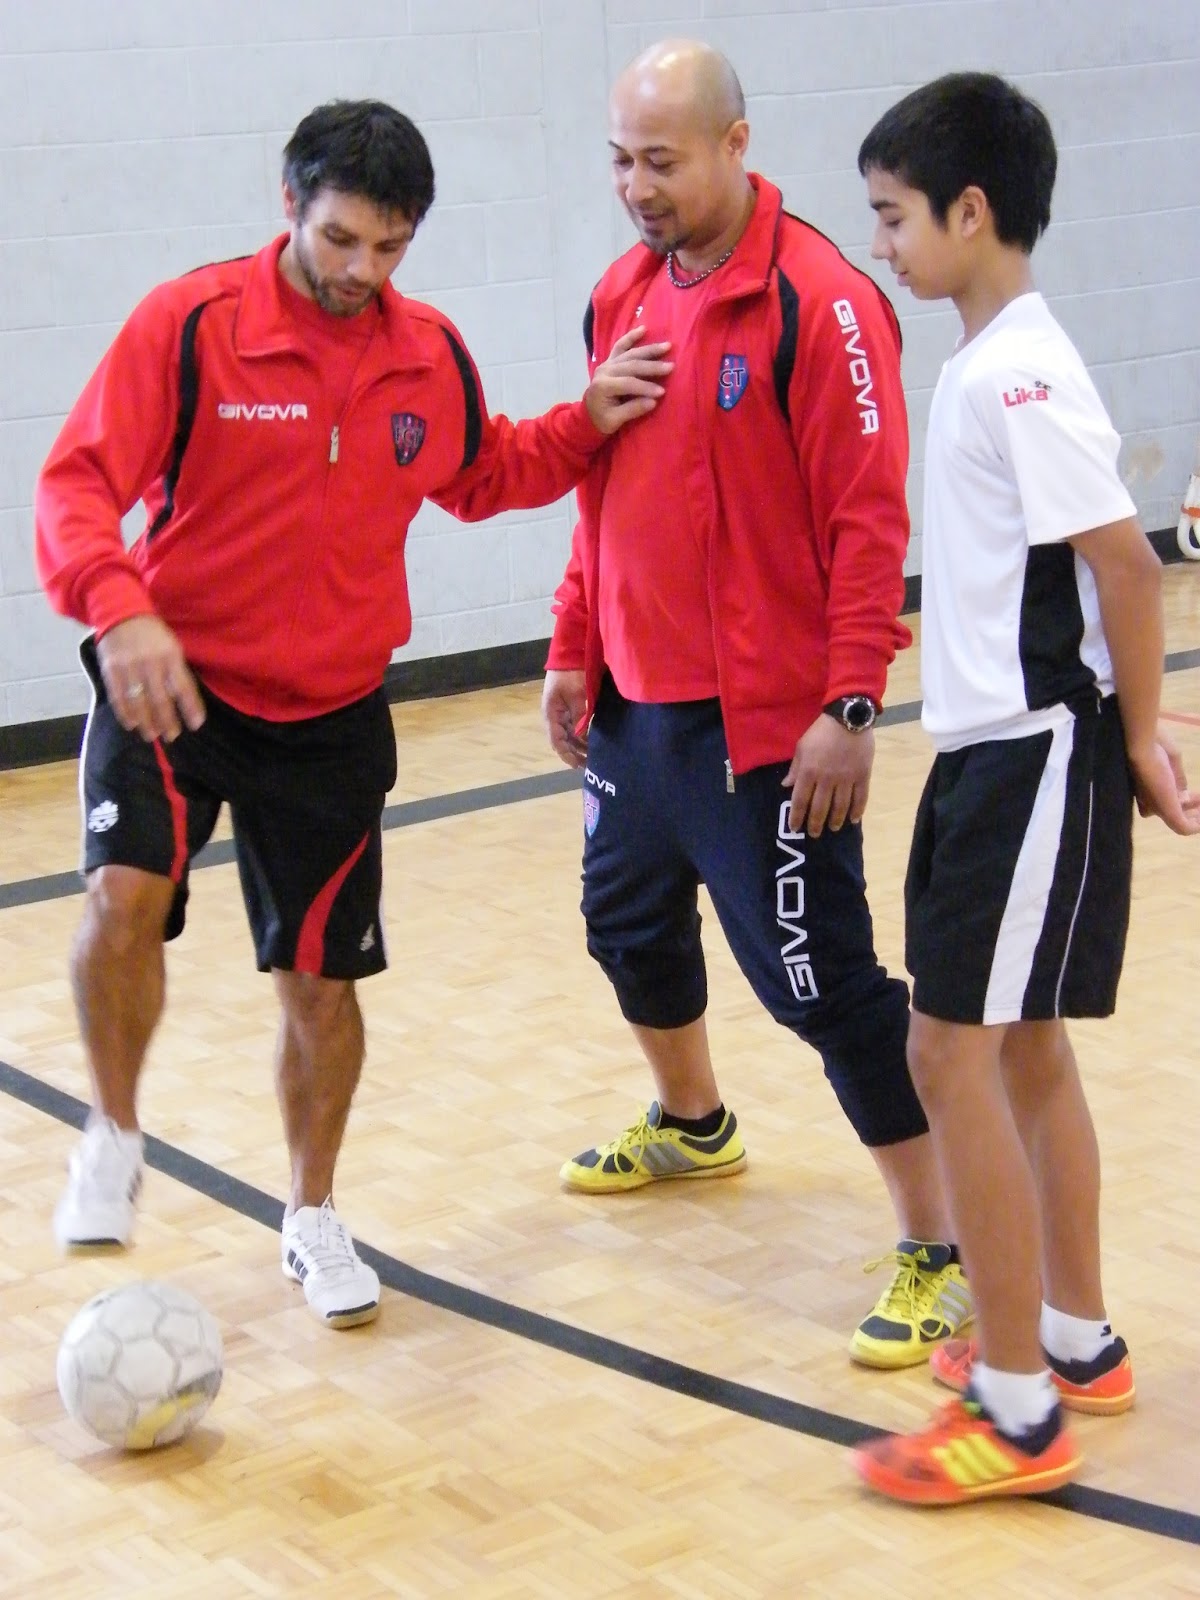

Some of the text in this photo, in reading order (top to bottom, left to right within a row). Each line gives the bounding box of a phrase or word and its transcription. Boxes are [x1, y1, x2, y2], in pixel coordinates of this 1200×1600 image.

[833, 298, 880, 436] GIVOVA
[1002, 387, 1048, 407] Lika
[217, 403, 308, 421] GIVOVA
